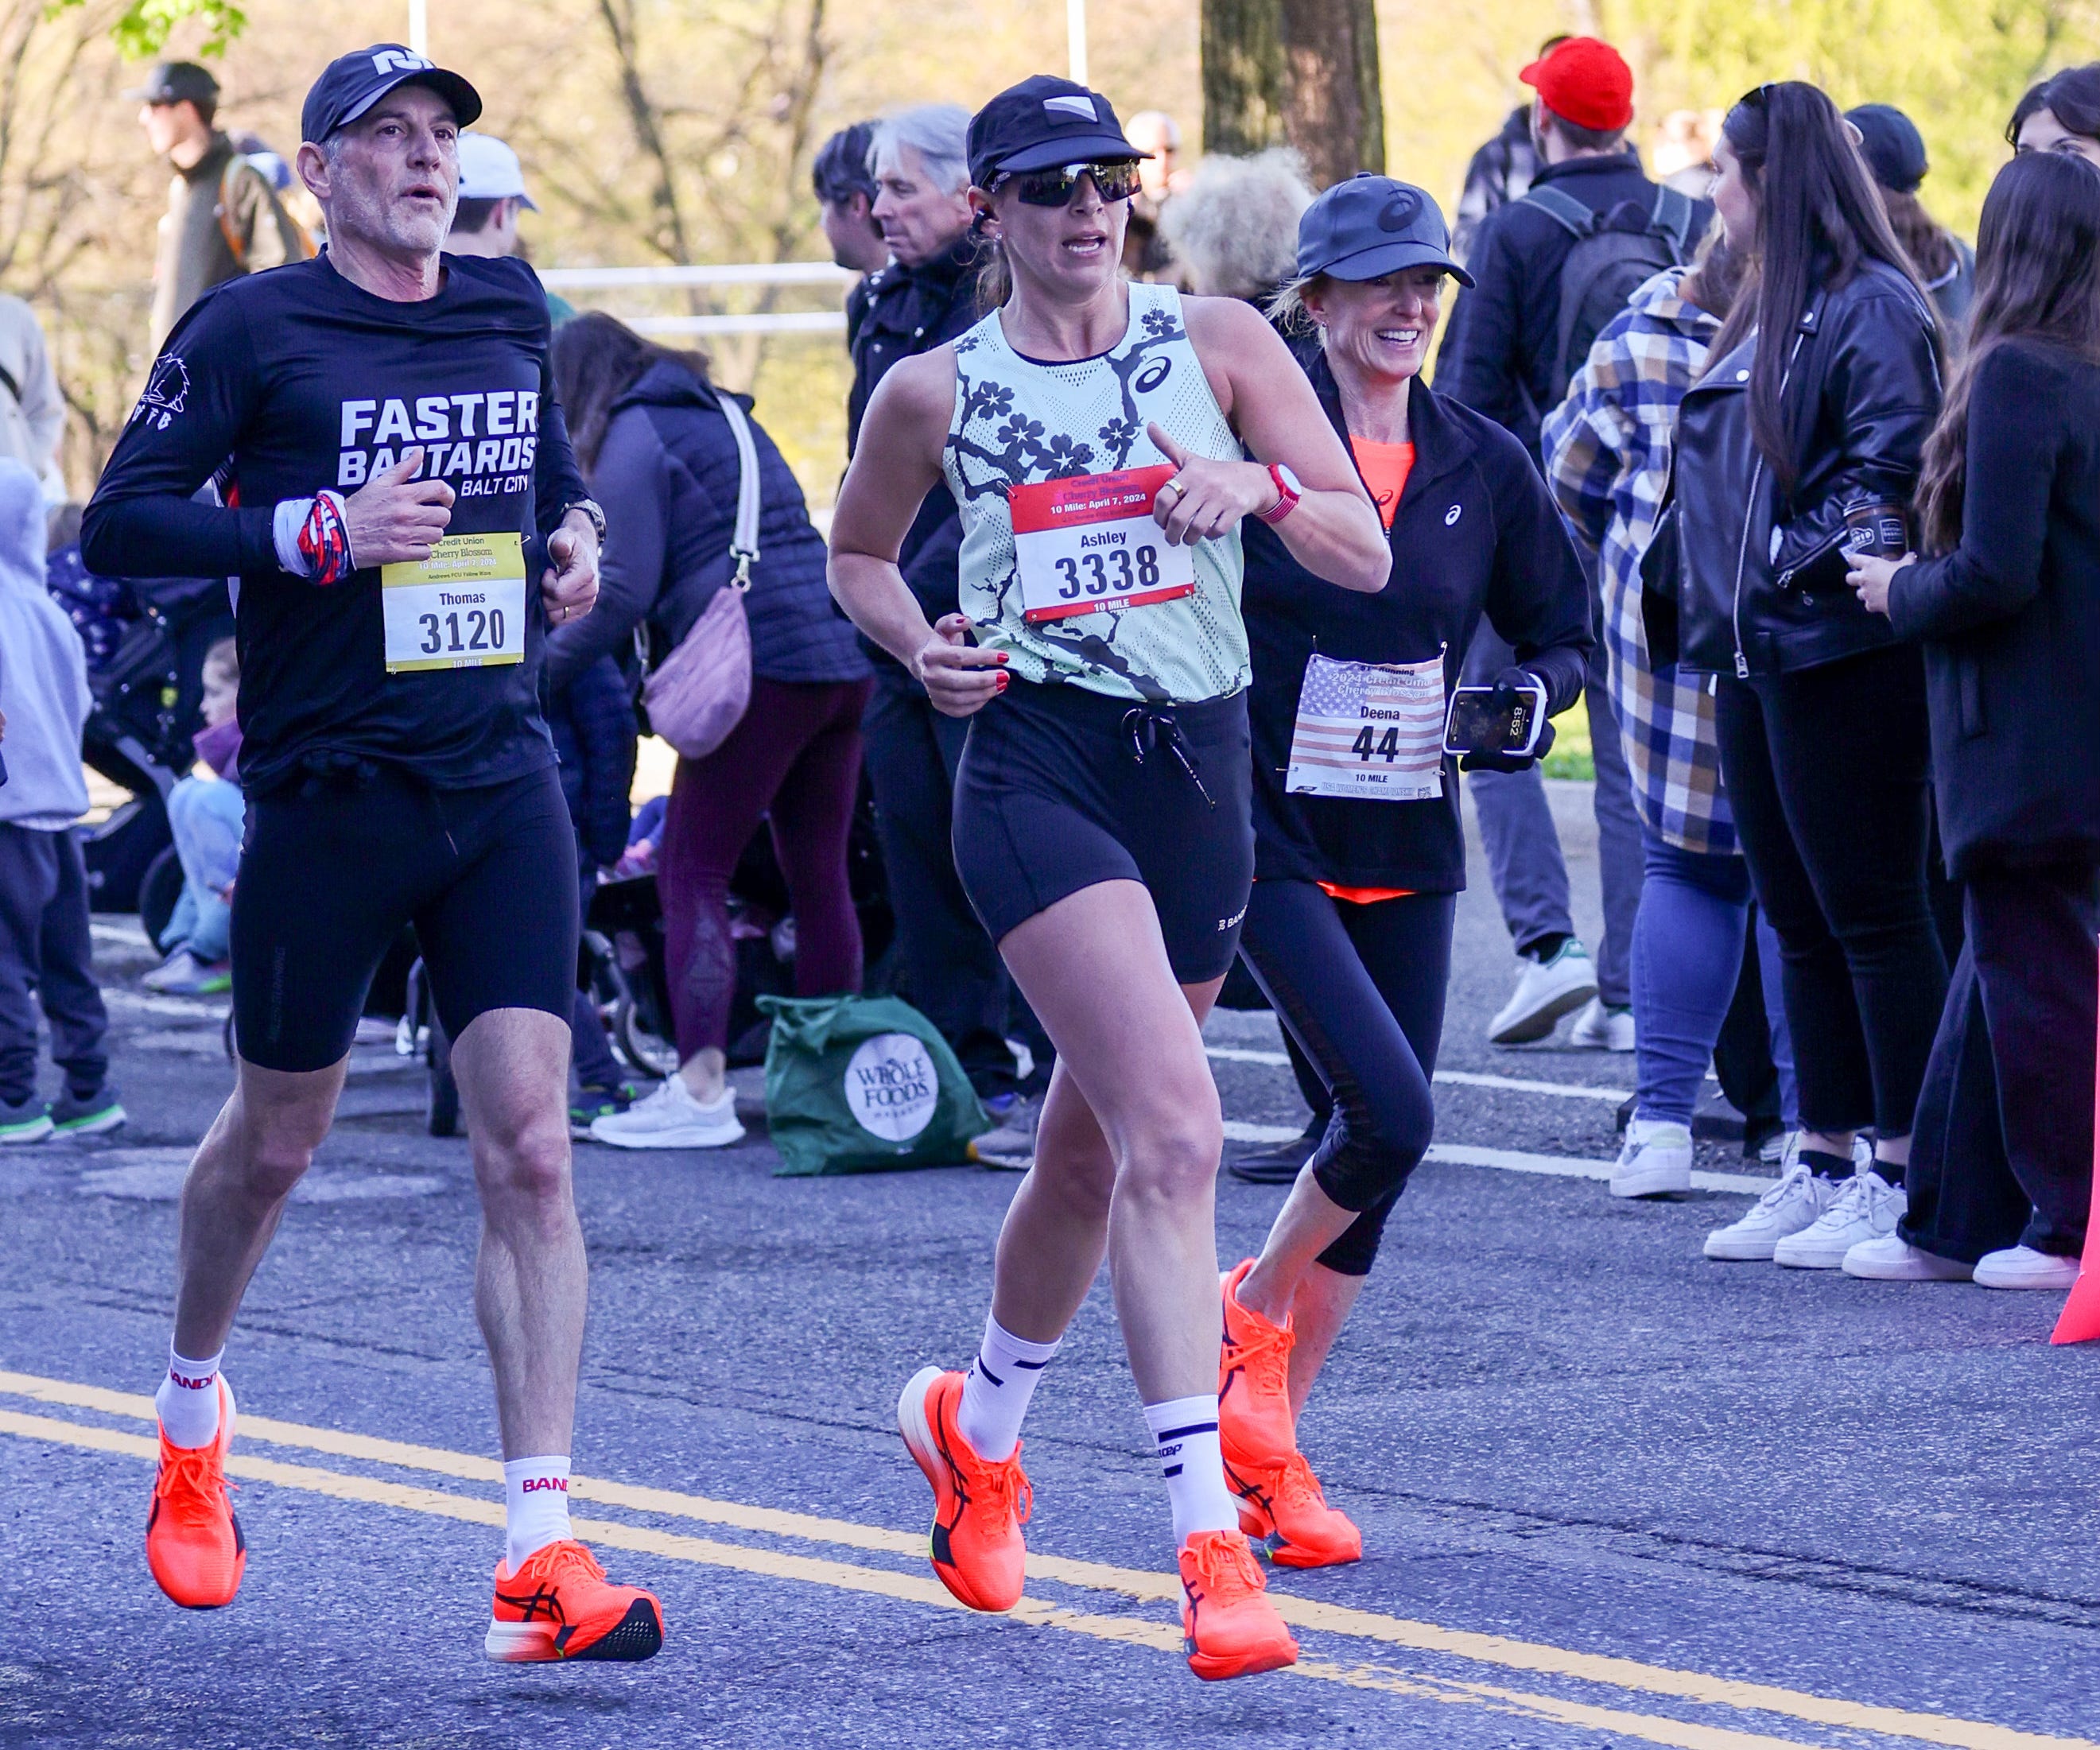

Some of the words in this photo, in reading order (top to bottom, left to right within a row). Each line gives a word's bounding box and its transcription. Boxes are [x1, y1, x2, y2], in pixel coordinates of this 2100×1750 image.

[341, 391, 539, 447] FASTER
[460, 478, 503, 497] BALT
[503, 475, 528, 493] CITY
[1050, 505, 1062, 514] 10
[1065, 502, 1086, 513] Mile:
[1089, 498, 1110, 510] April
[1112, 497, 1122, 506] 7,
[1124, 493, 1147, 503] 2024
[464, 537, 484, 545] Union
[1080, 531, 1127, 549] Ashley
[432, 549, 460, 560] Cherry
[461, 548, 493, 557] Blossom
[452, 560, 470, 570] April
[1054, 545, 1161, 600] 3338
[440, 593, 486, 606] Thomas
[1094, 603, 1106, 612] 10
[1108, 599, 1130, 610] MILE
[418, 608, 505, 654] 3120
[452, 659, 463, 669] 10
[464, 658, 483, 667] MILE
[1332, 673, 1362, 683] 2024
[1361, 705, 1400, 720] Deena
[1510, 707, 1523, 736] 8:52
[1351, 725, 1399, 763] 44
[1355, 774, 1365, 782] 10
[1368, 774, 1388, 783] MILE
[856, 1057, 926, 1085] WHOLE
[864, 1081, 930, 1108] FOODS
